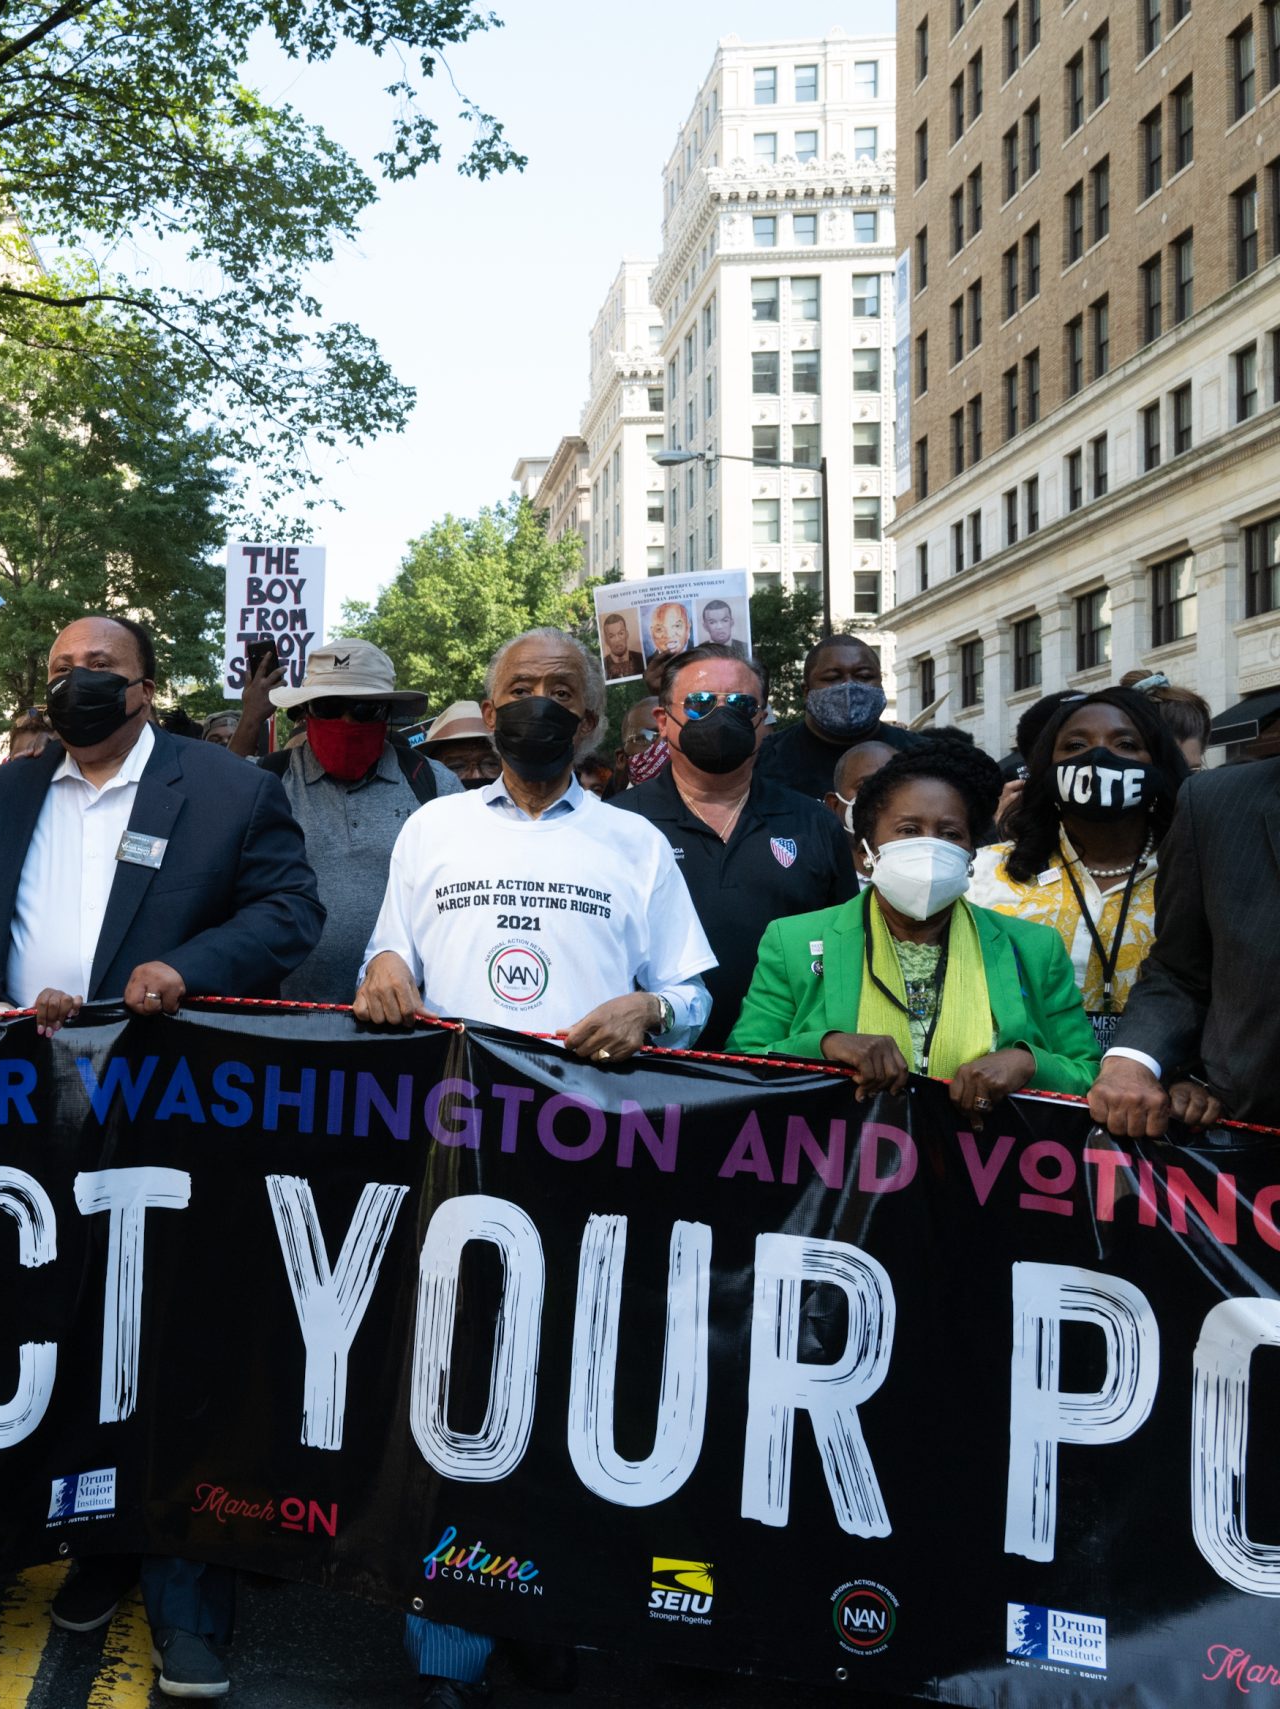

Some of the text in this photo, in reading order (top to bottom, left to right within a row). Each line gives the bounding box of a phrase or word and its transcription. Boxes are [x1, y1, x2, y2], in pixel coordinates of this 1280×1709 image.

[243, 546, 300, 575] THE
[247, 577, 307, 606] BOY
[240, 608, 308, 631] FROM
[1056, 765, 1145, 809] VOTE
[435, 880, 612, 903] NATIONAL ACTION NETWORK
[437, 894, 612, 919] MARCH ON FOR VOTING RIGHTS
[496, 914, 542, 931] 2021
[484, 941, 506, 963] NATIONAL
[530, 943, 553, 967] NETWORK
[496, 964, 539, 986] NAN
[75, 1055, 682, 1173] WASHINGTON
[718, 1109, 919, 1195] AND
[264, 1174, 897, 1539] YOUR
[1004, 1260, 1280, 1598] PO
[79, 1485, 113, 1498] Major
[80, 1474, 113, 1486] Drum
[77, 1498, 112, 1508] Institute
[191, 1483, 338, 1537] March ON
[422, 1525, 540, 1580] future
[440, 1567, 544, 1596] COALITION
[830, 1579, 900, 1608] NATIONAL ACTION NETWORK
[648, 1590, 714, 1614] SEIU
[649, 1610, 713, 1626] Stronger Together
[844, 1606, 886, 1630] NAN
[1052, 1614, 1103, 1636] Drum
[1052, 1629, 1102, 1649] Major
[1052, 1645, 1102, 1663] Institute
[1006, 1658, 1108, 1681] PEACE JUSTICE EQUITY
[1202, 1644, 1280, 1694] Mar
